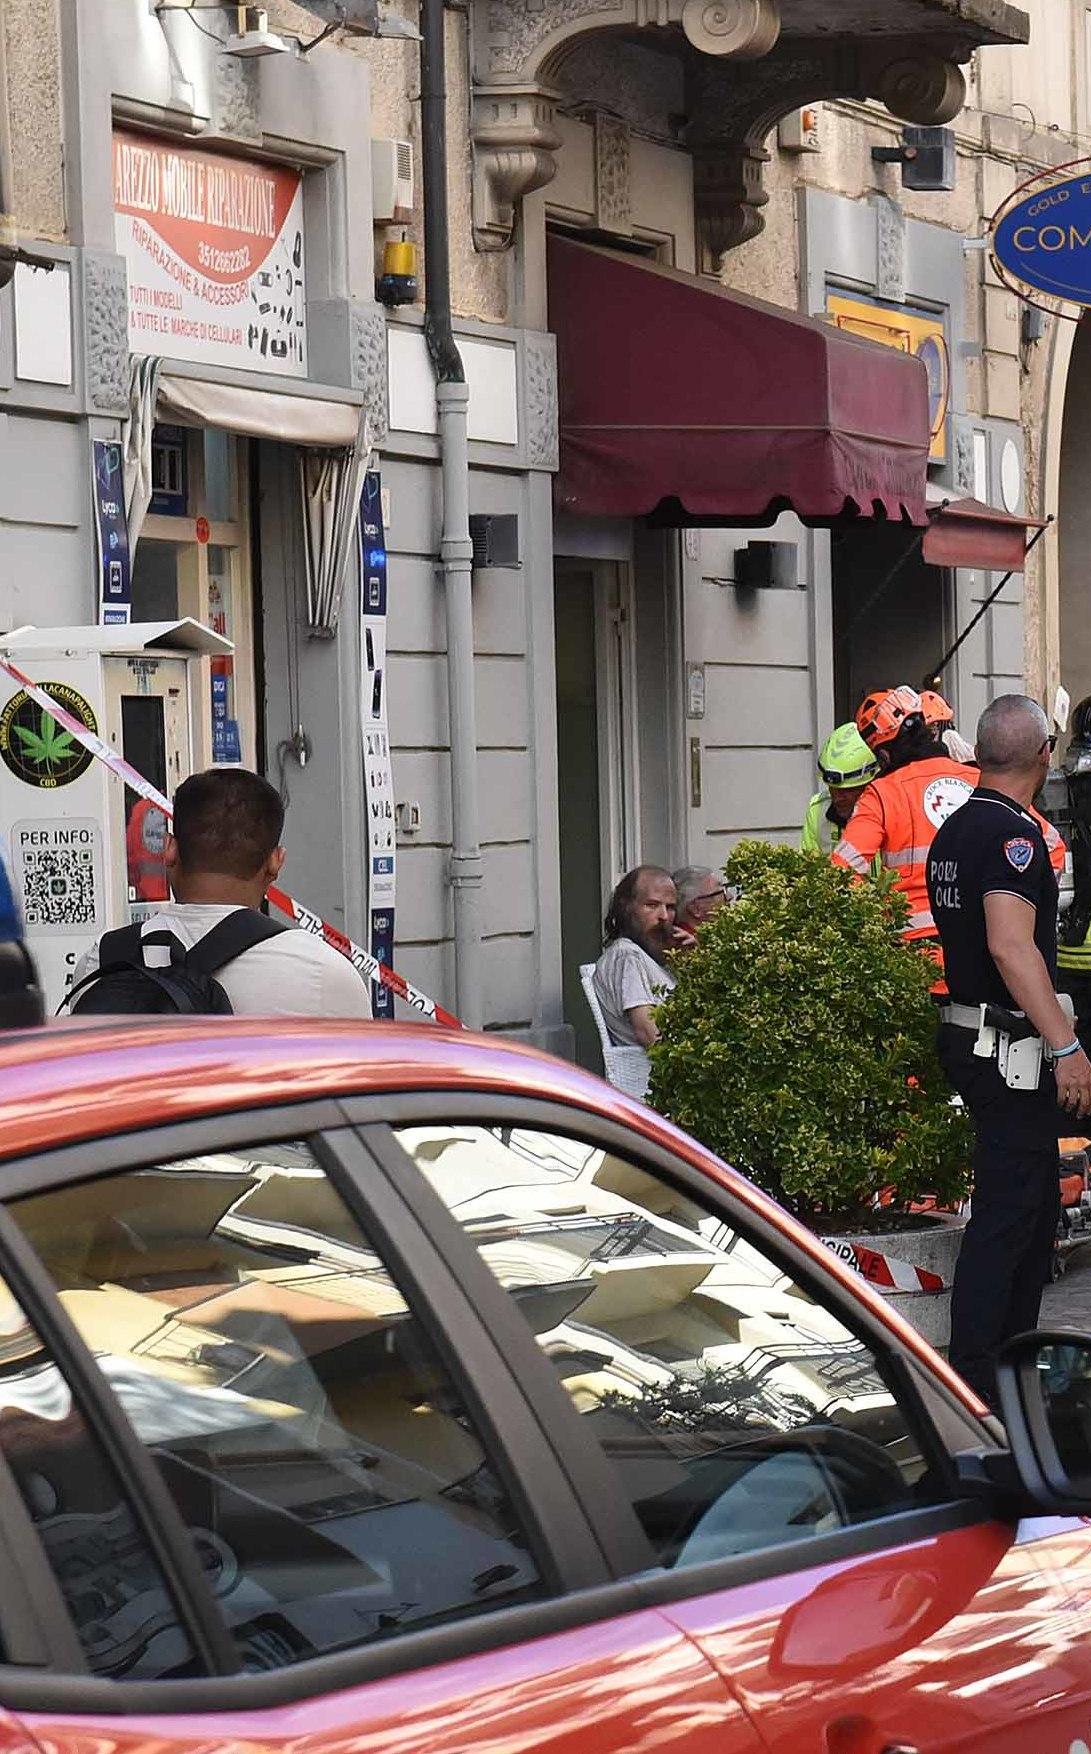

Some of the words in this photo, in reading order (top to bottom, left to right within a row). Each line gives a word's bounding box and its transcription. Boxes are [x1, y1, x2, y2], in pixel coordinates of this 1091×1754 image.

[114, 143, 160, 213] AREZZO
[160, 153, 206, 222] MOBILE
[207, 165, 277, 239] RIPARAZIONE
[1028, 190, 1070, 217] GOLD
[131, 220, 192, 292] RIPARAZIONE
[201, 279, 249, 305] ACCESSORI
[20, 832, 49, 845] PER
[54, 829, 95, 845] INFO:
